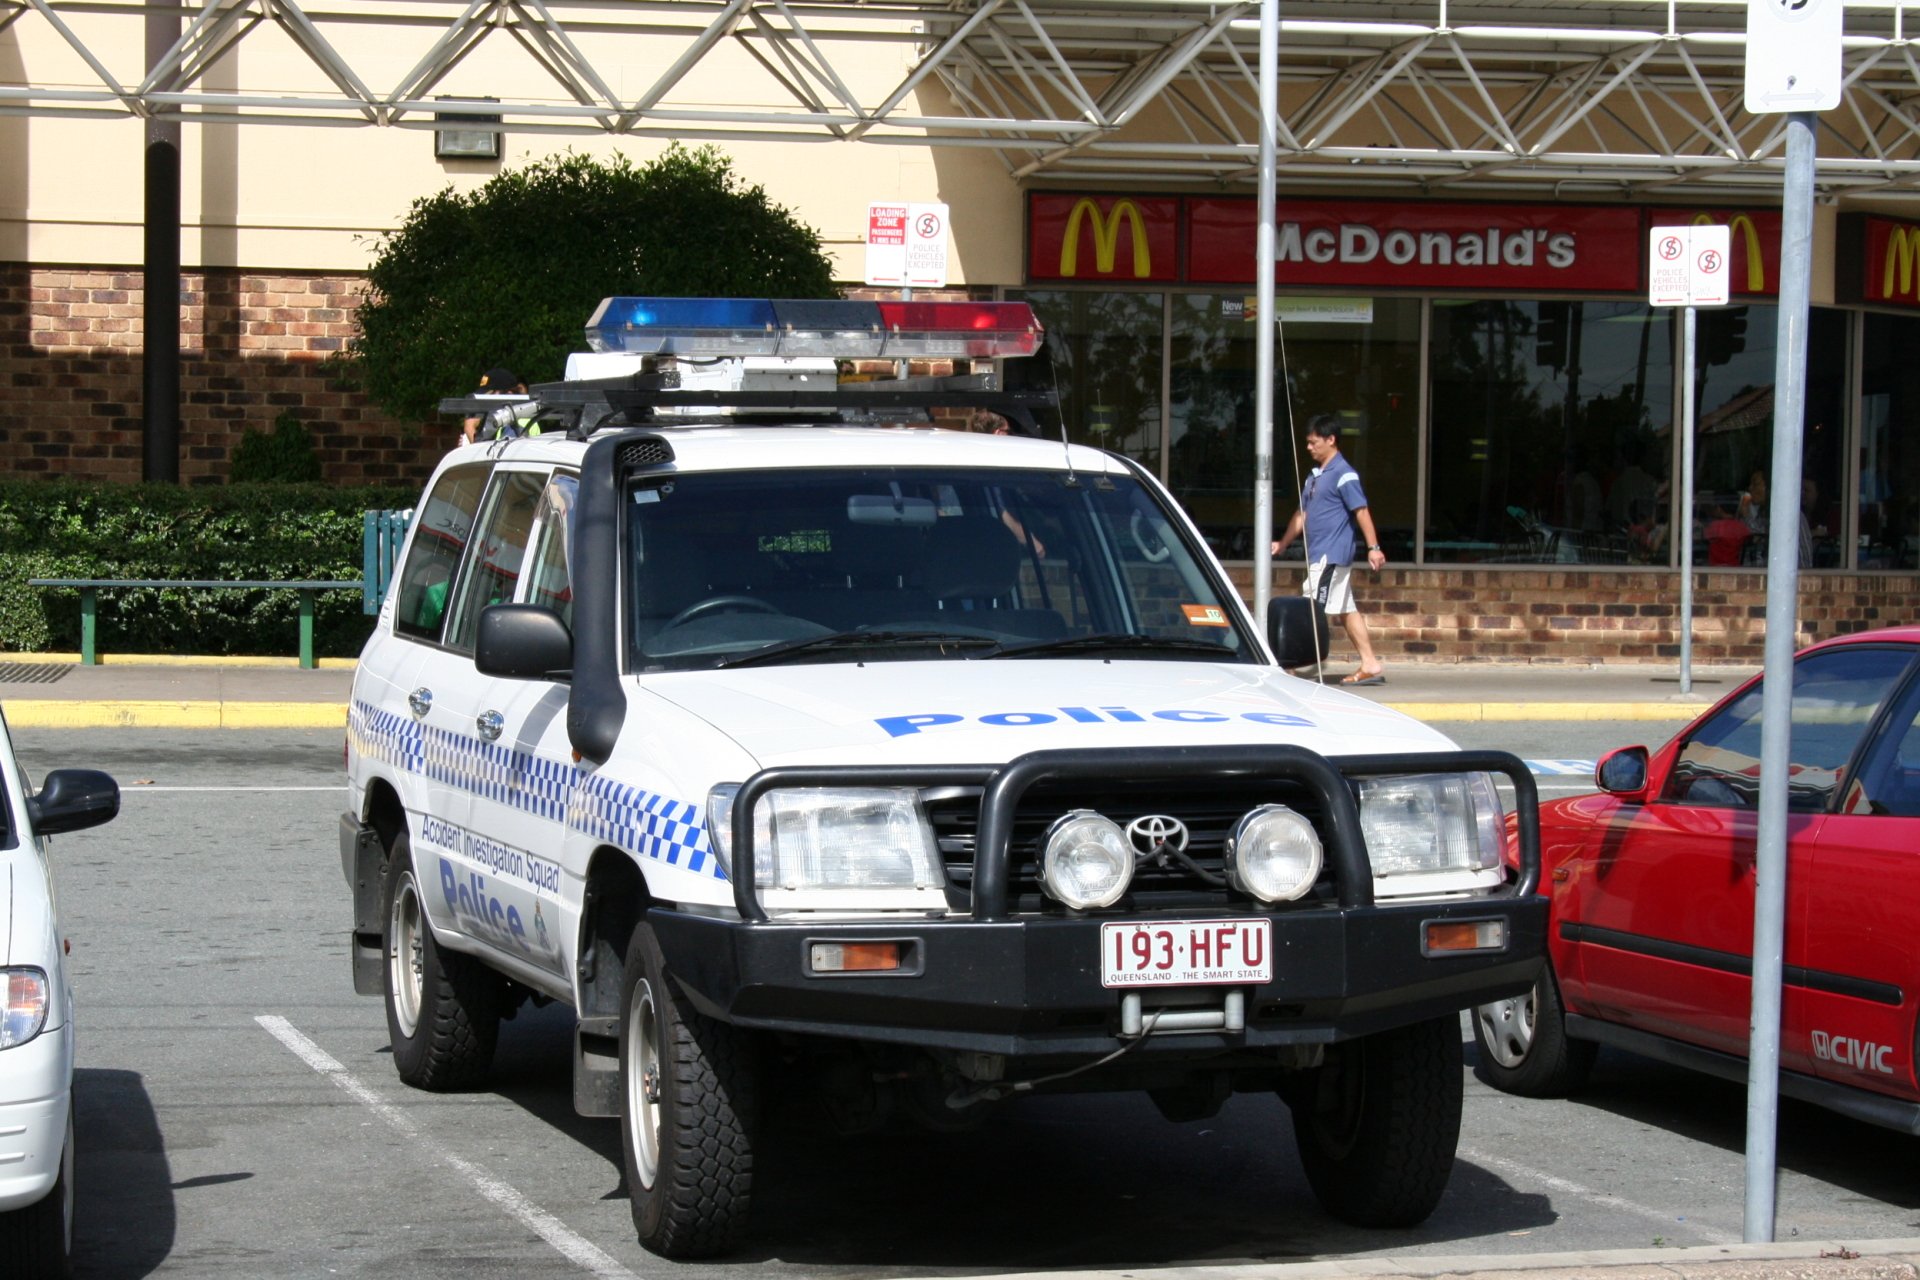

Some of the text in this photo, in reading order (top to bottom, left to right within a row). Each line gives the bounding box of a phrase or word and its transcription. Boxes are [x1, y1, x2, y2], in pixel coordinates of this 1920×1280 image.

[870, 207, 905, 218] LOADING
[876, 217, 899, 227] ZONE
[913, 243, 941, 252] POLICE
[1272, 222, 1576, 268] McDonald's
[909, 252, 945, 261] VEHICLES
[908, 261, 945, 269] EXCEPTED
[1656, 268, 1684, 276] POLICE
[1652, 284, 1688, 292] EXCEPTED
[1222, 300, 1243, 311] New
[874, 706, 1318, 738] Police
[422, 814, 560, 894] Accident Investigation Squad
[439, 857, 527, 941] Police
[1110, 972, 1172, 983] QUEENSLAND
[1182, 971, 1199, 980] THE
[1203, 970, 1233, 980] SMART
[1237, 970, 1263, 979] STATE
[1830, 1035, 1893, 1074] CIVIC
